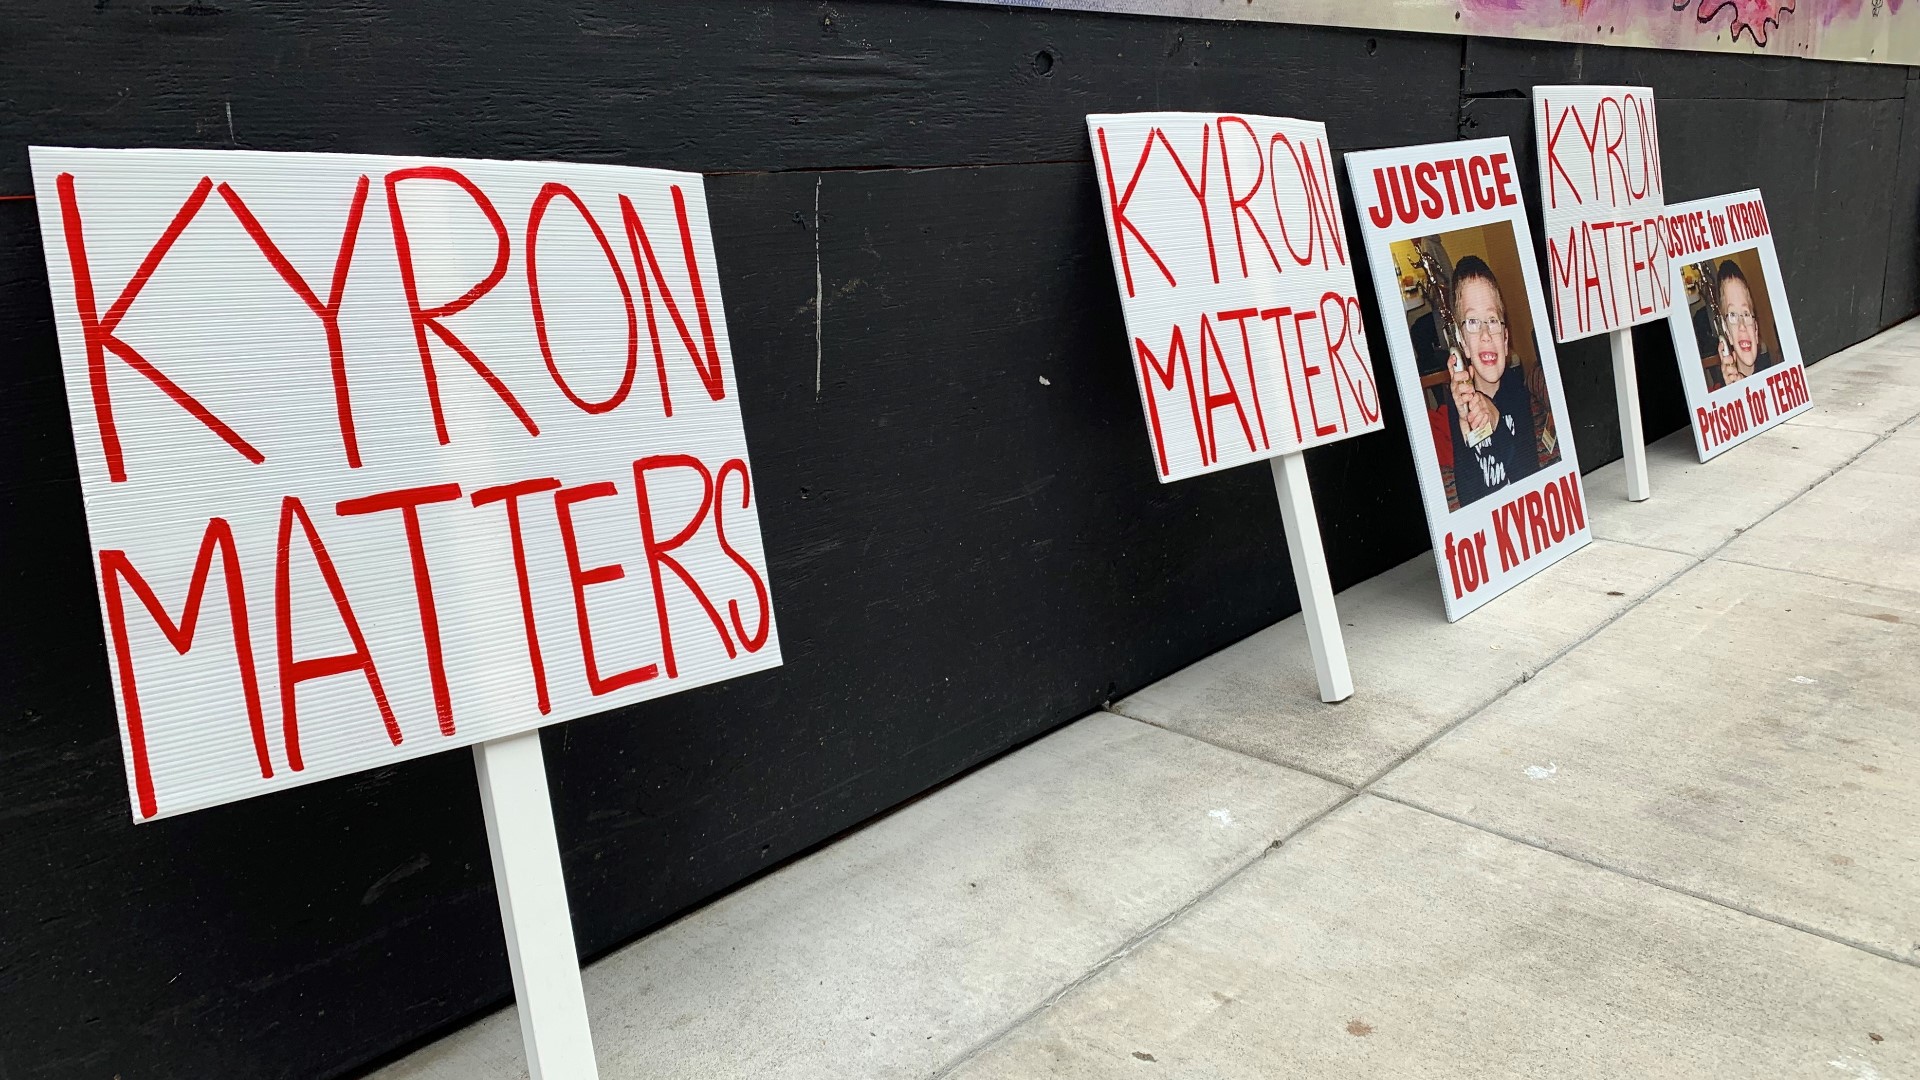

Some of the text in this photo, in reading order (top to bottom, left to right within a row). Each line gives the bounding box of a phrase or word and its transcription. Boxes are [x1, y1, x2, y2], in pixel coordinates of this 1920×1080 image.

[1097, 116, 1345, 298] KYRON
[1368, 152, 1517, 229] JUSTICE
[1544, 94, 1661, 209] KYRON
[1549, 214, 1671, 340] MATTERS
[1664, 200, 1769, 258] USTICE for KYRON
[56, 166, 726, 484] KYRON
[1134, 291, 1380, 478] MATTERS
[1696, 364, 1810, 451] Prison for TERRI
[1444, 471, 1585, 600] for KYRON
[99, 454, 770, 819] MATTERS
